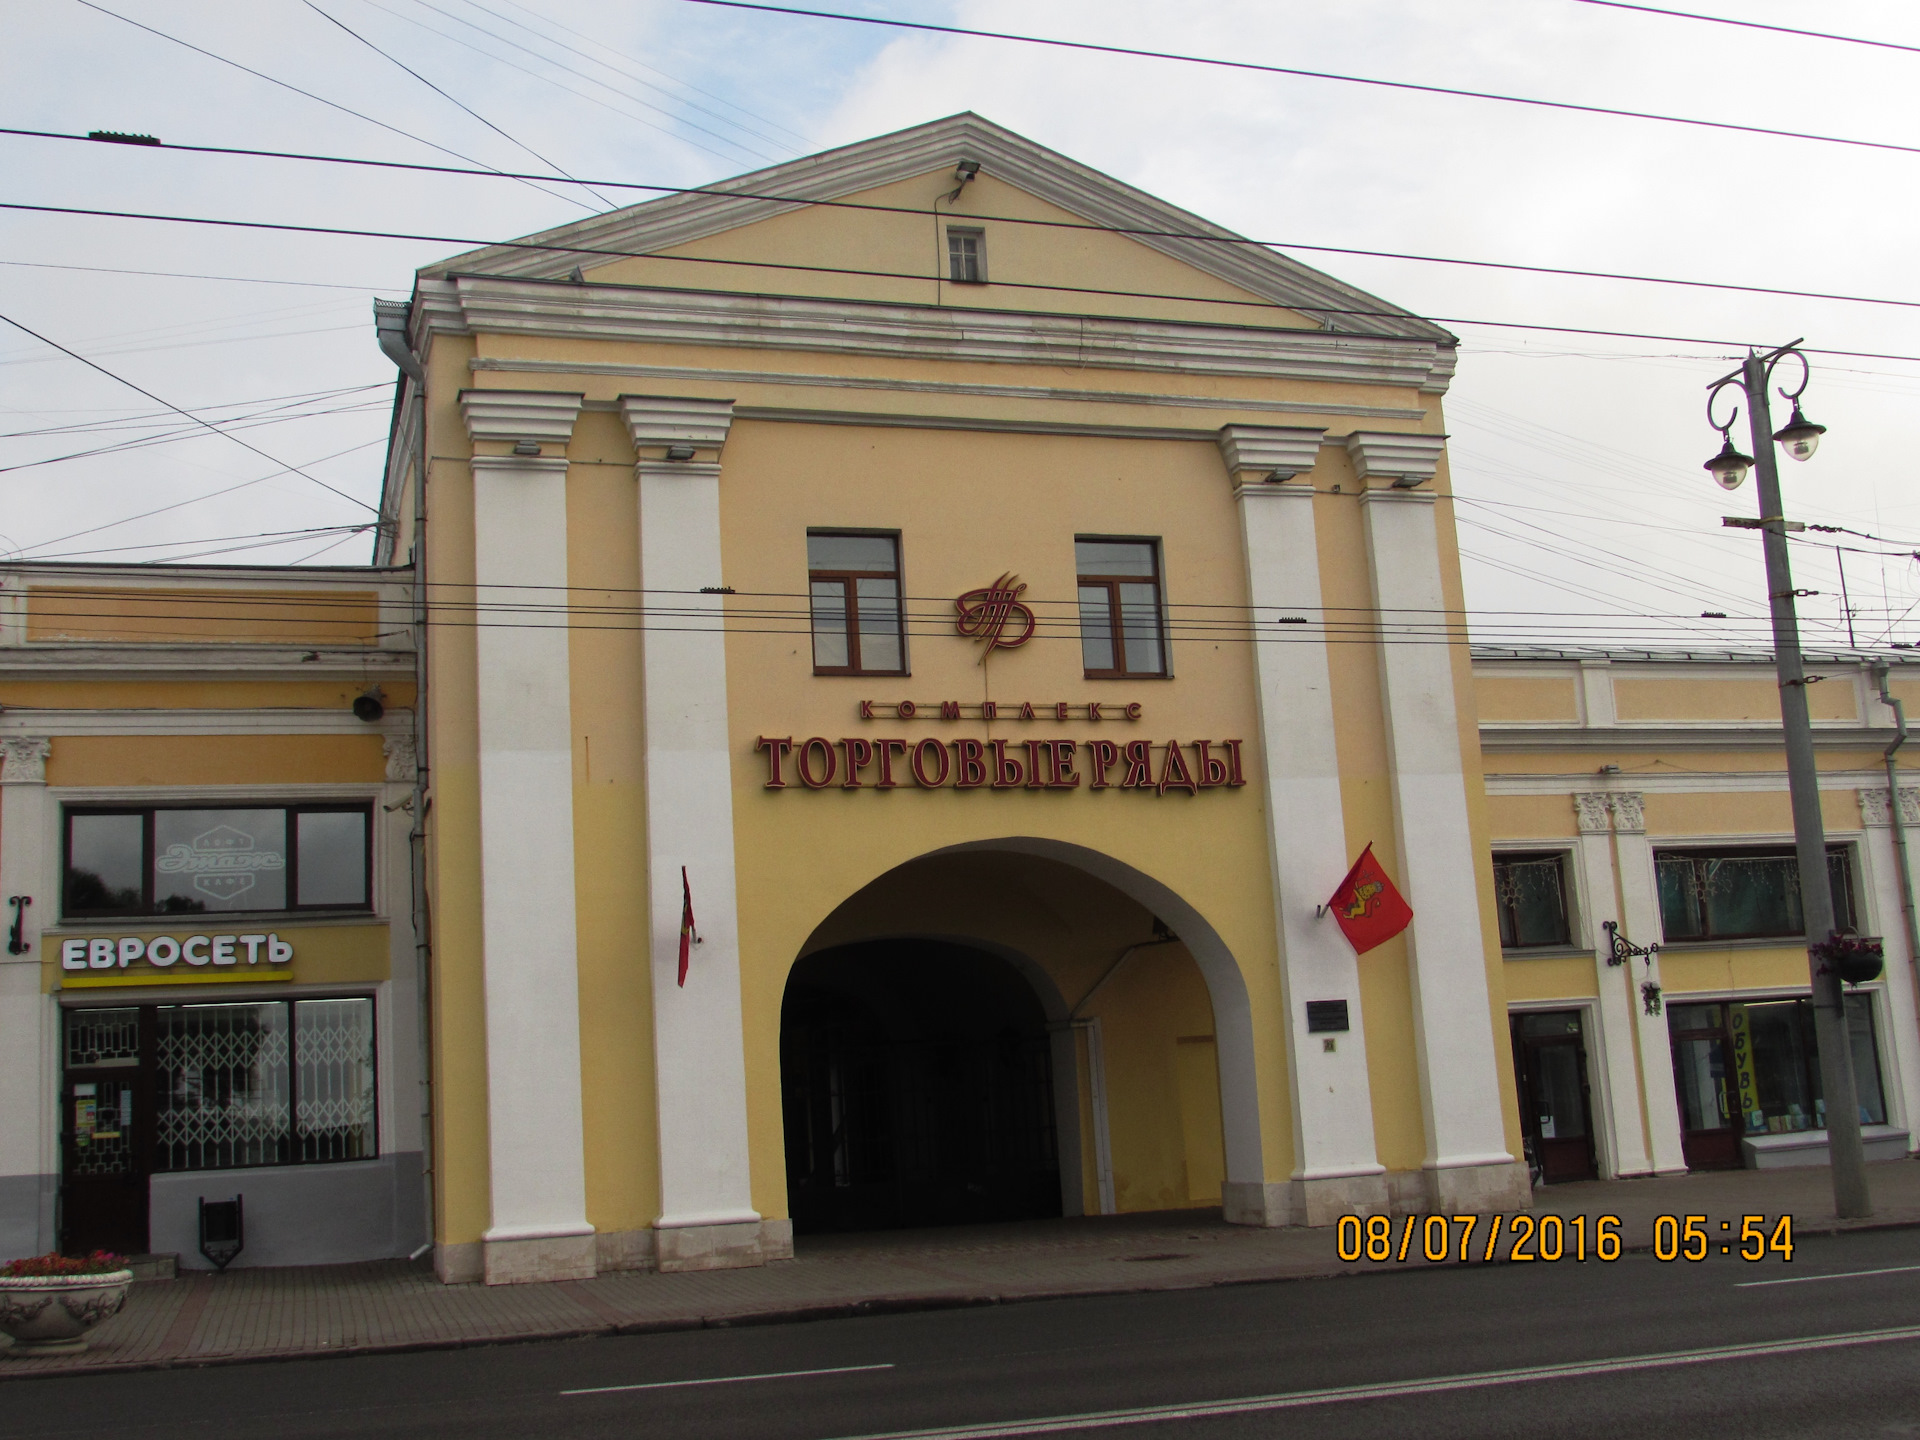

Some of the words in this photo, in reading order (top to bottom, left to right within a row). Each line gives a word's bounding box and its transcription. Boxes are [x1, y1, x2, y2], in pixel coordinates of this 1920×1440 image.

[860, 699, 1142, 721] КОМПЛЕКС
[756, 735, 1081, 789] ТОРГОВЫЕ
[1088, 738, 1247, 796] РЯДЫ
[62, 932, 294, 970] ЕВРОСЕТЬ
[1732, 1012, 1753, 1109] ОБУВЬ
